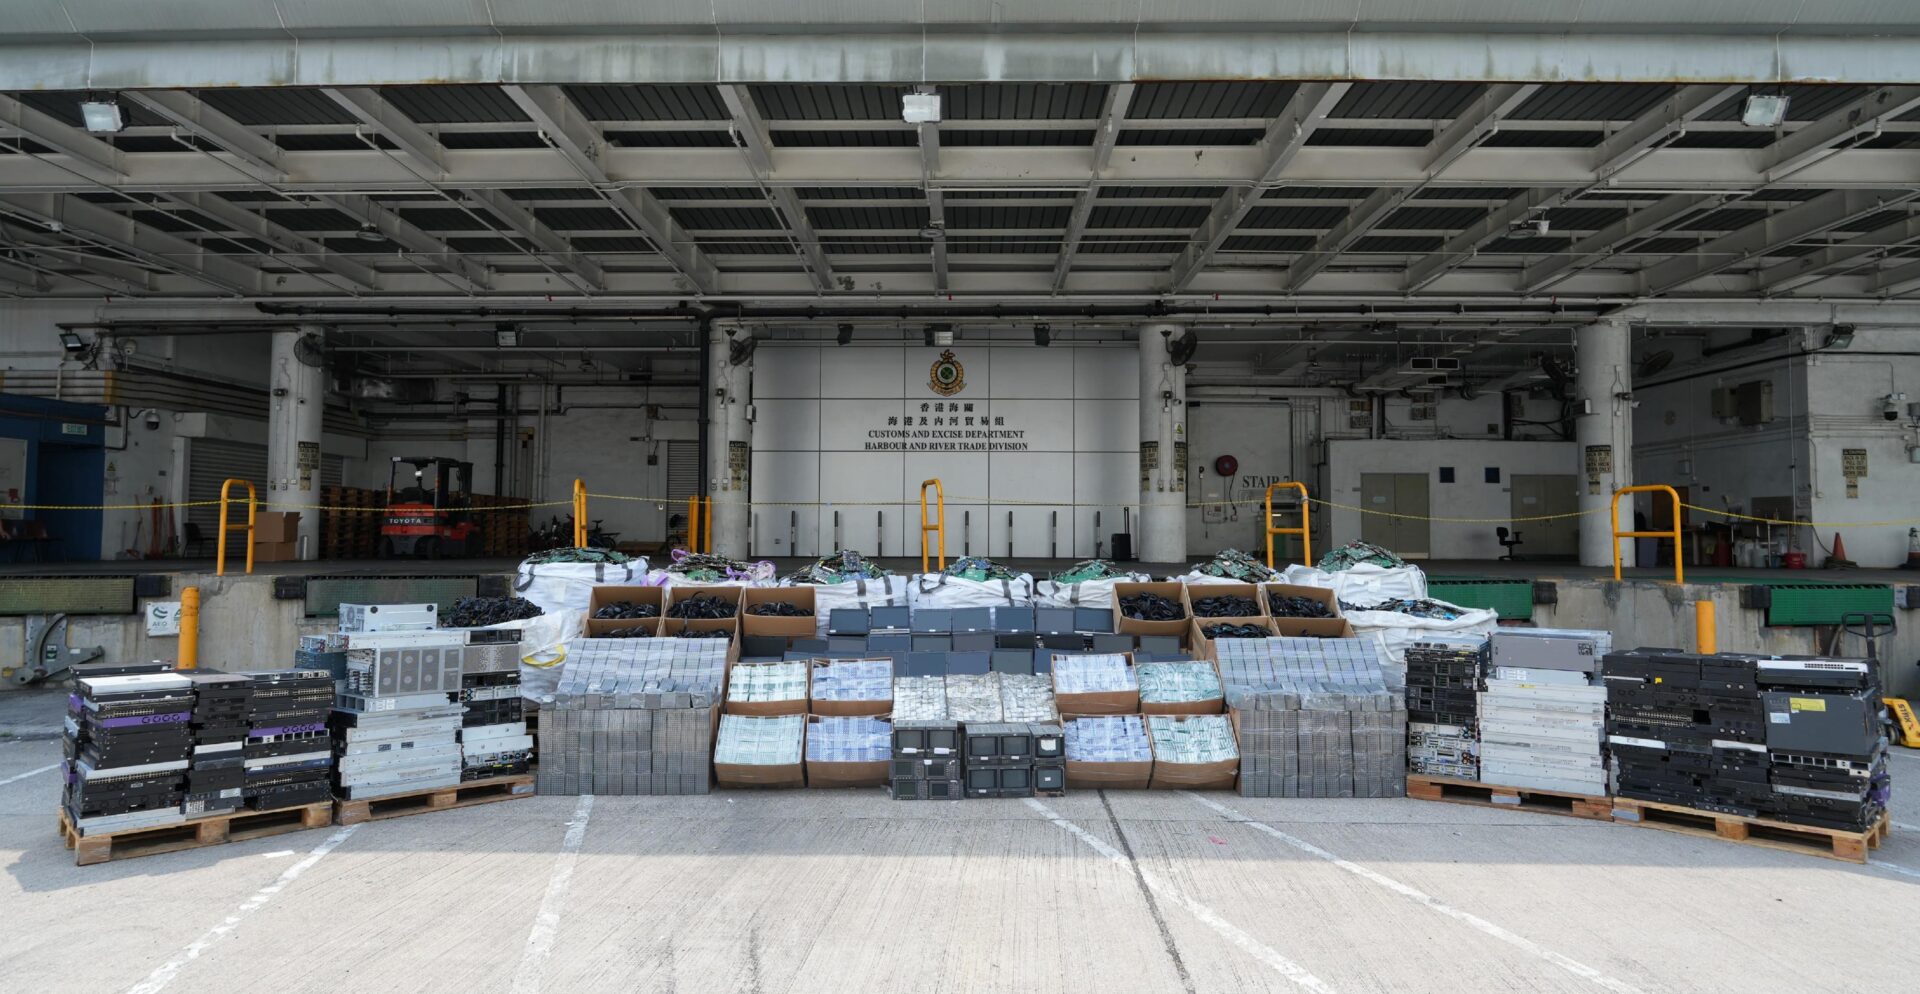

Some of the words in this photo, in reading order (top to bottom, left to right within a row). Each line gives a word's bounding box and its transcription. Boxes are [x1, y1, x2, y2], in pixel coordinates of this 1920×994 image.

[920, 402, 974, 412] 香港海關
[868, 430, 910, 438] CUSTOMS
[911, 430, 930, 438] AND
[932, 430, 963, 438] EXCISE
[965, 430, 1024, 438] DEPARTMENT
[864, 442, 907, 450] HARBOUR
[909, 442, 927, 450] AND
[929, 442, 956, 450] RIVER
[957, 442, 987, 450] TRADE
[989, 442, 1028, 450] DIVISION
